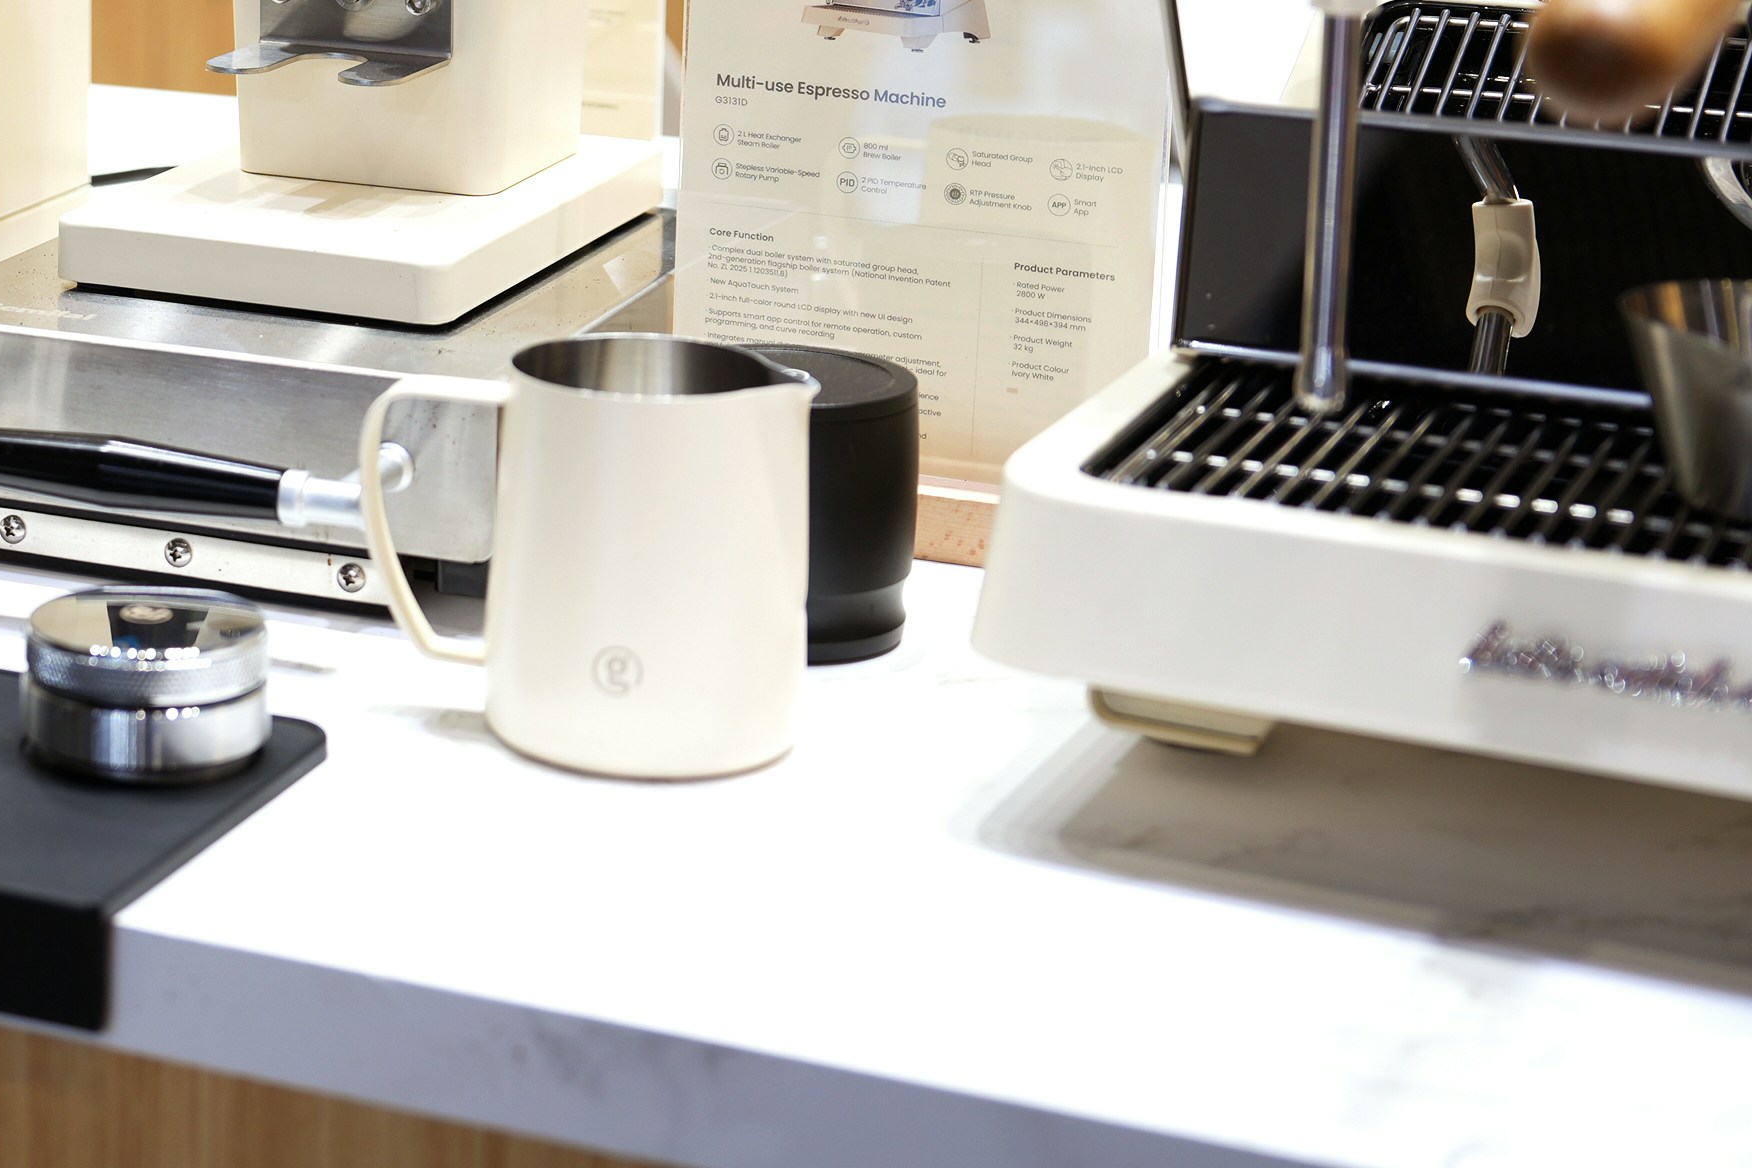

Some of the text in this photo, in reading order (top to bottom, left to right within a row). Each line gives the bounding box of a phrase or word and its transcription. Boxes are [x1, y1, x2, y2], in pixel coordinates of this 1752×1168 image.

[716, 74, 947, 108] Multi-use Espresso Machine
[715, 96, 748, 107] G3131D
[737, 139, 780, 150] Steam Boiler
[766, 134, 801, 144] Exchanger
[863, 151, 901, 161] Brew Boiler
[972, 151, 1033, 164] Saturated Group
[971, 160, 992, 168] Head
[736, 163, 820, 178] Stepless Variable-Speed
[1108, 166, 1123, 175] LCD
[735, 171, 779, 183] Rotary Pump
[840, 178, 855, 187] PID
[1076, 173, 1104, 182] Display
[867, 177, 879, 185] PID
[880, 178, 927, 190] Temperature
[861, 186, 888, 195] Control
[984, 191, 1015, 201] Pressure
[969, 199, 1032, 212] Adjustment Knob
[1052, 201, 1067, 209] APP
[1074, 199, 1097, 208] Smart
[1073, 208, 1089, 216] App
[709, 227, 774, 243] Core Function
[711, 244, 919, 276] Complex dual boiler system with saturated group head,
[708, 262, 719, 270] No.
[730, 264, 748, 273] 2025
[708, 253, 951, 288] 2nd-generation flagship boiler system (National Invention Patent
[1014, 262, 1115, 281] Product Parameters
[710, 277, 798, 294] New AquaTouch System
[1017, 282, 1065, 293] Rated Power
[1016, 290, 1035, 299] 2800
[739, 296, 772, 307] full-color
[774, 300, 796, 309] round
[798, 303, 812, 311] LCD
[814, 305, 841, 316] display
[843, 308, 859, 318] with
[860, 311, 876, 319] new
[886, 313, 913, 324] design
[1015, 308, 1092, 323] Product Dimensions
[705, 316, 835, 340] programming, and curve recording
[709, 308, 923, 340] Supports smart app control for remote operation, custom
[707, 331, 745, 344] Integrates
[1013, 334, 1073, 348] Product Weight
[1024, 344, 1033, 354] kg
[896, 355, 941, 368] adjustment,
[916, 367, 934, 375] ideal
[1012, 361, 1069, 374] Product Colour
[1012, 370, 1054, 381] Ivory White
